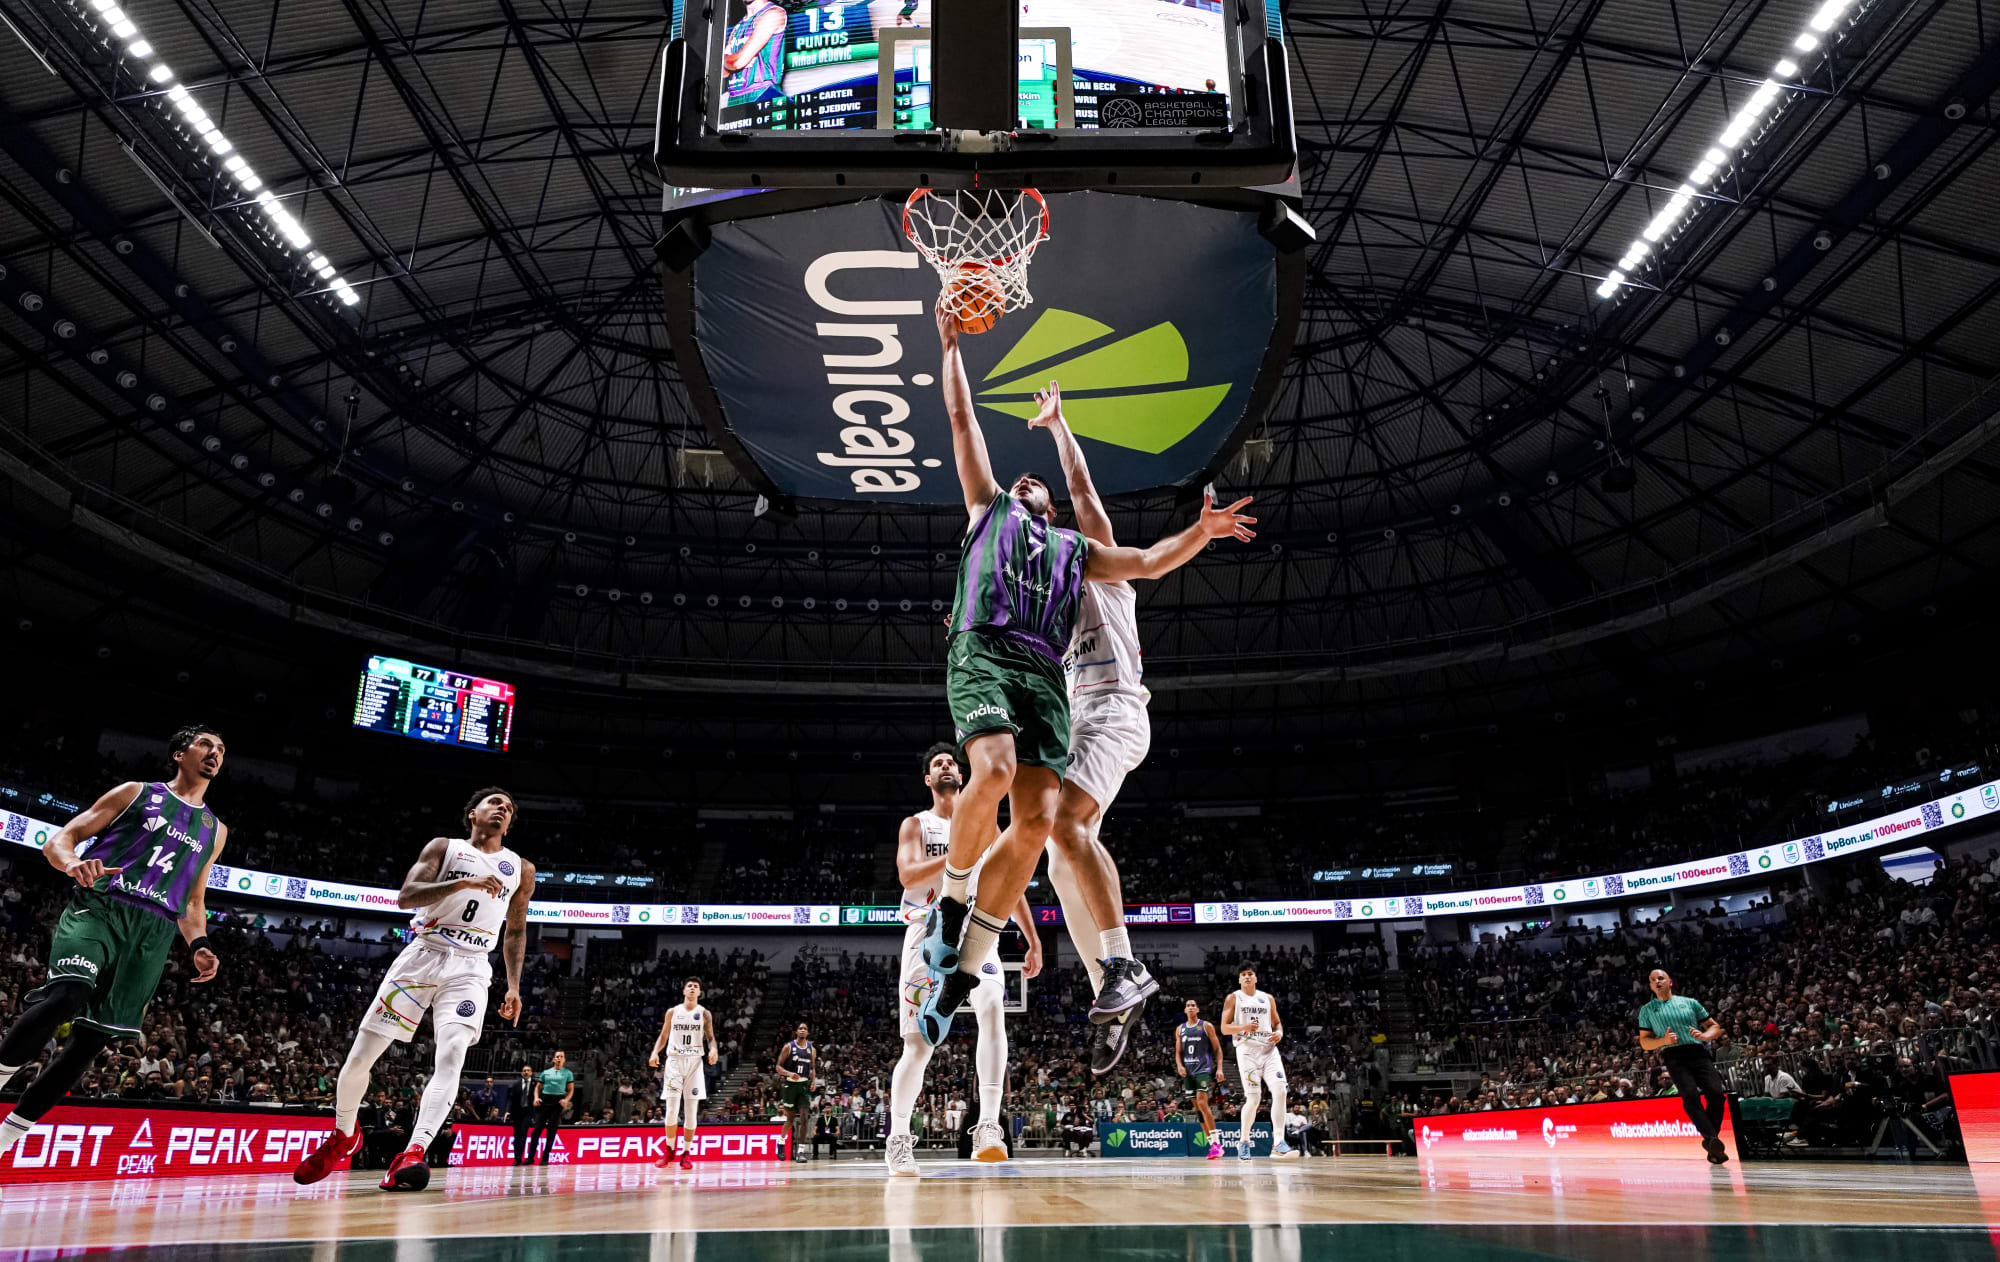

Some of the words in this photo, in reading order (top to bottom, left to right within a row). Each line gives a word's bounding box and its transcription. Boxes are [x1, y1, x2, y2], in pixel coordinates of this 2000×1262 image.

[805, 5, 844, 33] 13
[796, 31, 849, 50] PUNTOS
[801, 94, 811, 103] 11
[819, 88, 853, 100] CARTER
[898, 84, 909, 92] 11
[1073, 81, 1092, 90] VAN
[1093, 82, 1116, 91] BECK
[801, 108, 812, 117] 14
[819, 102, 861, 115] DJEDOVIC
[897, 98, 910, 106] 13
[1144, 101, 1214, 109] BASKETBALL
[1145, 109, 1224, 118] CHAMPIONS
[819, 117, 845, 129] TILLIE
[1145, 118, 1188, 126] LEAGUE
[804, 249, 942, 493] Unicaja
[416, 669, 431, 680] 77
[965, 702, 1010, 723] málag
[166, 824, 204, 853] Unicaja
[1826, 817, 1922, 851] bpBon.us/1000euros
[925, 843, 948, 857] PETK
[147, 845, 177, 874] 14
[1627, 864, 1727, 889] bpBon.us/1000euros
[112, 874, 170, 907] Andalucía
[309, 887, 399, 906] bpBon.us/1000eur
[463, 899, 479, 923] 8
[1140, 906, 1168, 915] ALIAGA
[1426, 894, 1523, 911] bpBon.us/1000euros
[527, 908, 610, 920] Bon.us/1000euros
[702, 911, 791, 921] bpBon.us/1000euros
[868, 909, 900, 922] UNICA
[1041, 909, 1057, 921] 21
[1124, 914, 1168, 923] ETKIMSPOR
[1242, 906, 1332, 917] bpBon.us/1000euros
[57, 954, 98, 976] málag
[382, 1011, 401, 1022] STAR
[682, 1034, 692, 1046] 10
[1188, 1045, 1194, 1054] 0
[1129, 1129, 1182, 1139] Fundación
[12, 1124, 113, 1168] ORT
[165, 1127, 259, 1165] PEAK
[262, 1129, 332, 1163] SPO
[466, 1135, 506, 1159] PEAK
[577, 1136, 666, 1158] PEAK
[1129, 1139, 1169, 1150] Unicaja
[116, 1154, 157, 1175] PEAK
